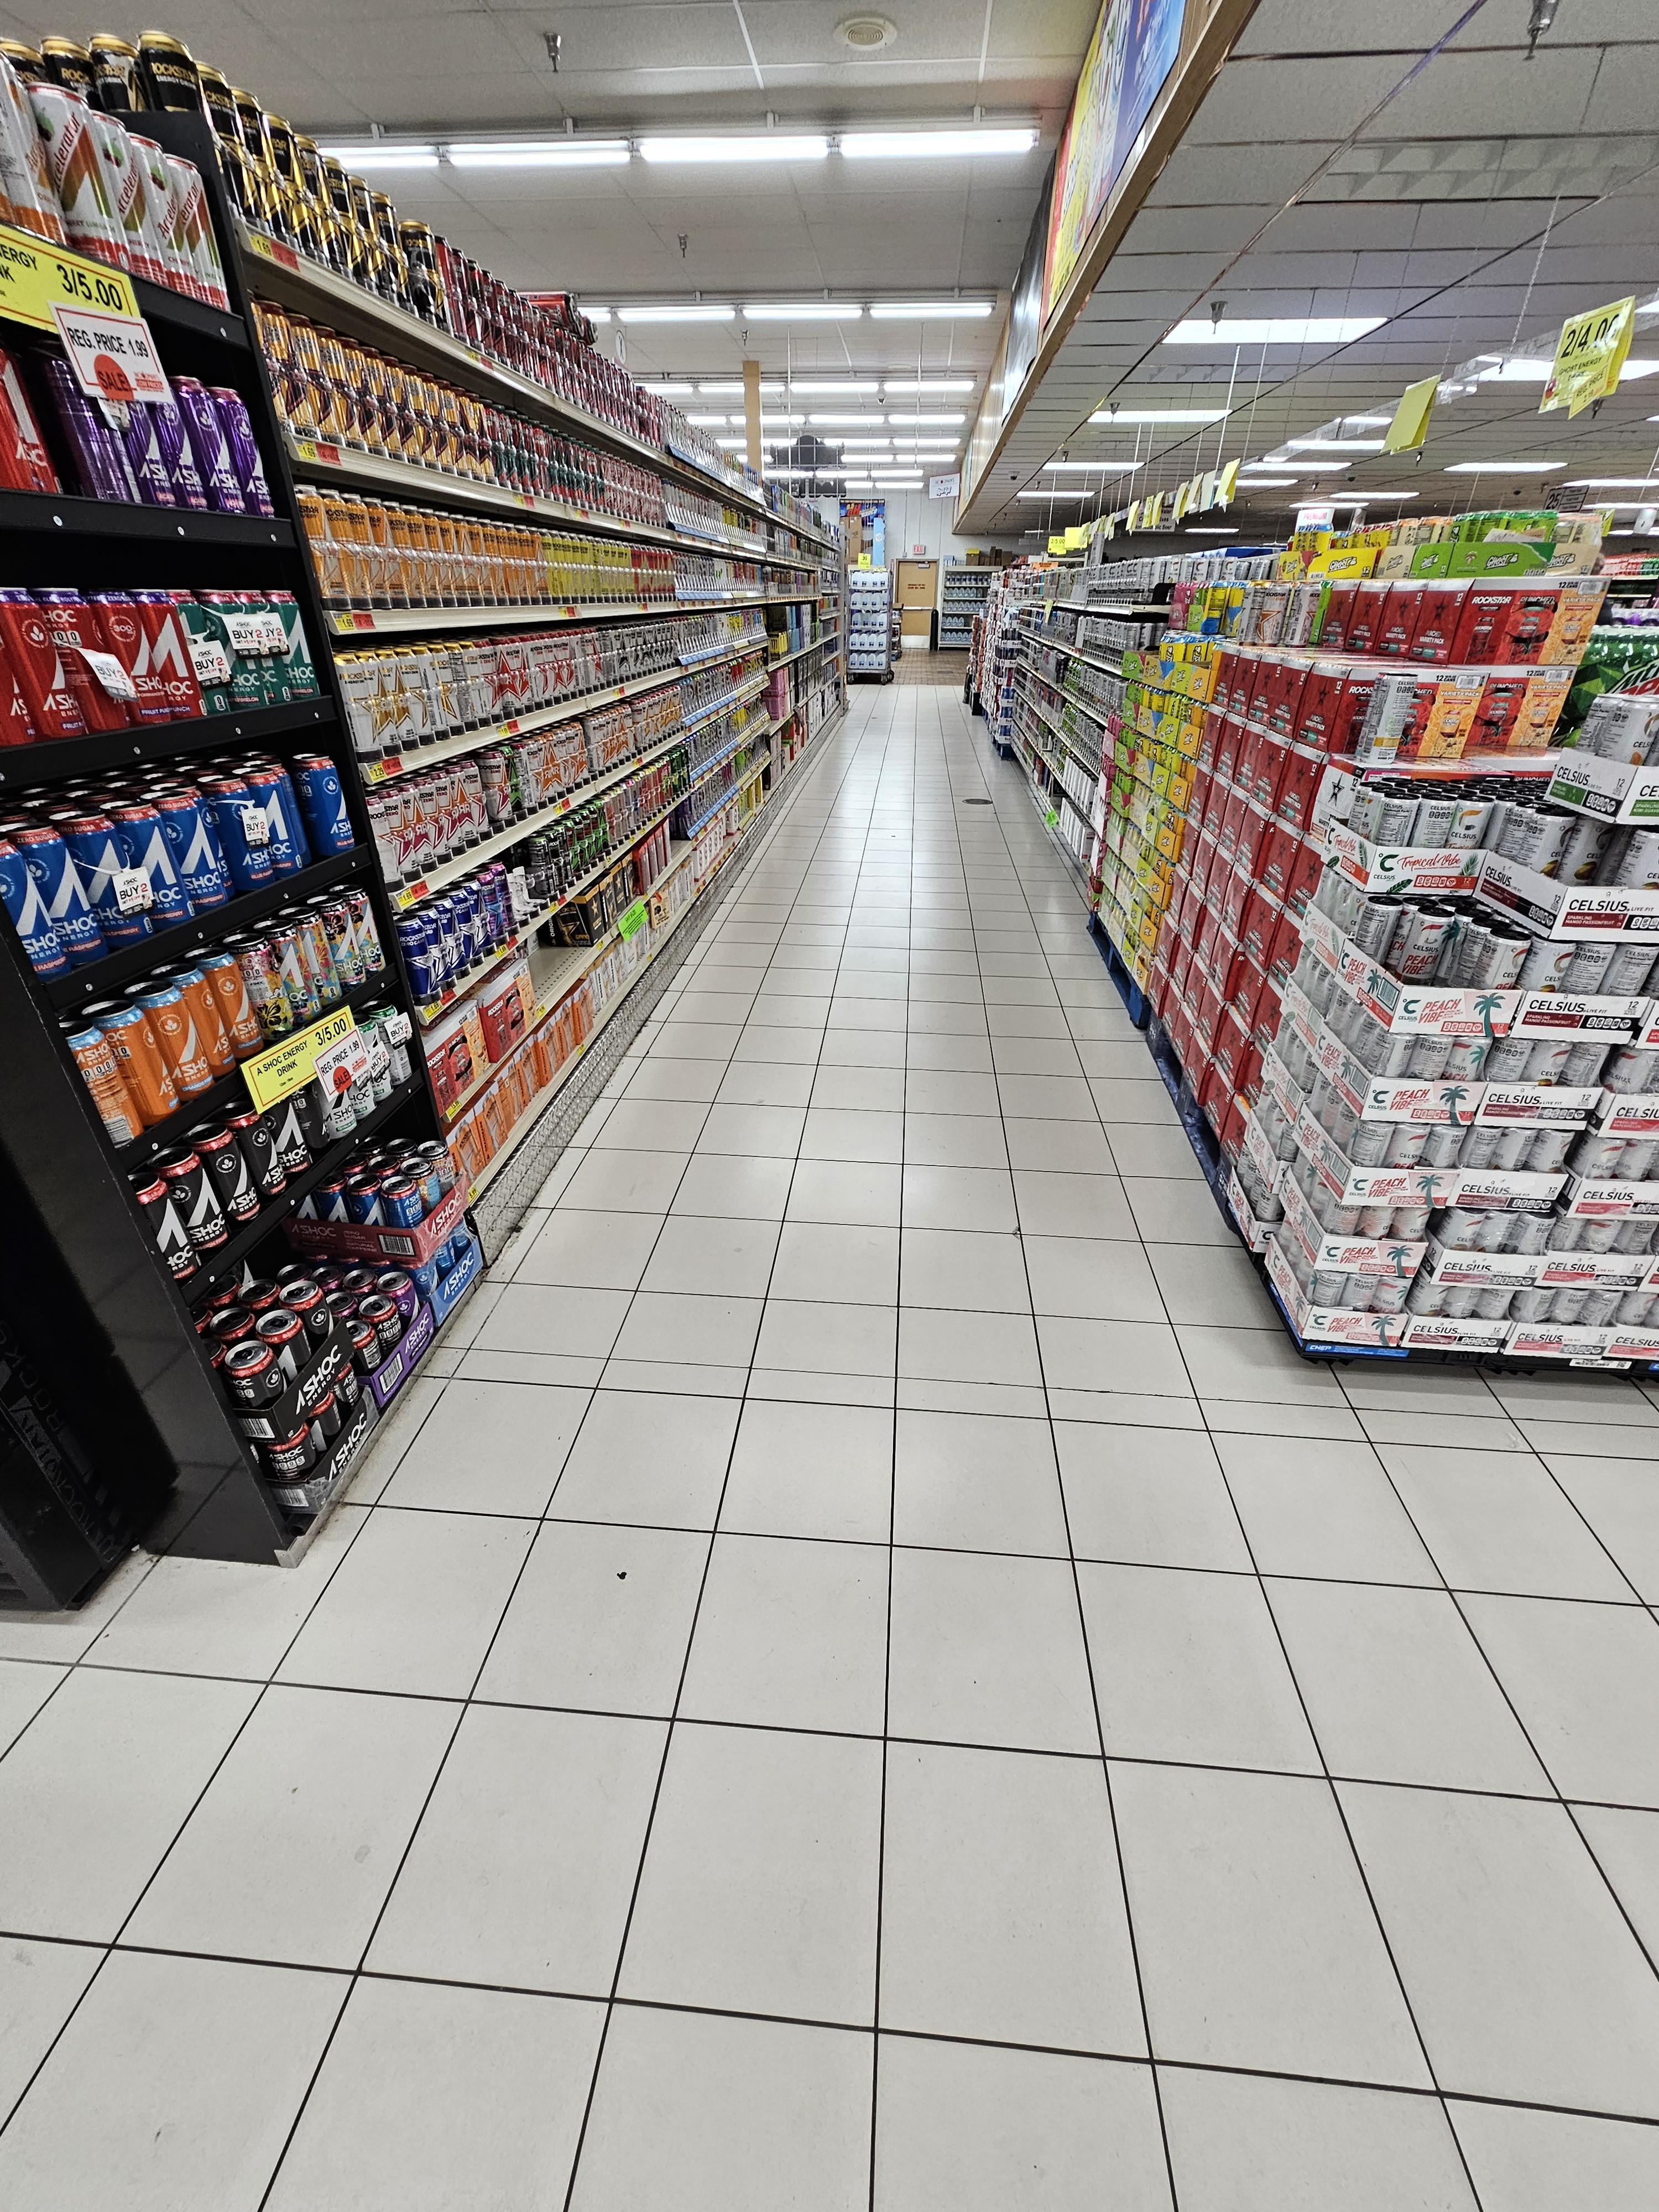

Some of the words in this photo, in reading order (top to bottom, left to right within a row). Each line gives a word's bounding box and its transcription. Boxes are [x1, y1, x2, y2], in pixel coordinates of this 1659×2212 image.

[56, 264, 122, 311] 3/5.00
[67, 327, 96, 350] REG.
[95, 332, 127, 354] PRICE
[128, 337, 149, 358] 1.99
[1578, 356, 1603, 370] ENERGY
[1547, 491, 1561, 509] 25
[1329, 556, 1351, 573] GHOST
[1485, 554, 1511, 570] GHOST
[1472, 596, 1514, 604] ROCKSTAR
[342, 618, 353, 628] 1.69
[232, 629, 254, 639] BUY
[255, 629, 263, 639] 2
[195, 657, 215, 671] BUY
[215, 656, 225, 666] 2
[95, 665, 118, 679] BUY
[1337, 681, 1342, 690] 12
[373, 766, 384, 776] 2.29
[1557, 765, 1591, 786] CELSIUS
[1617, 778, 1625, 788] 12
[246, 822, 260, 832] BUY
[1451, 831, 1477, 839] CELSIUS
[1397, 855, 1438, 872] Tropical
[1438, 853, 1462, 867] Vibe
[1485, 865, 1511, 887] CELSIUS
[119, 885, 139, 900] BUY
[140, 883, 148, 893] 2
[403, 891, 413, 901] 1.69
[1554, 894, 1561, 904] 12
[1568, 899, 1629, 912] CELSIUS
[1577, 946, 1600, 955] CELSIUS
[1405, 954, 1438, 964] PEACH
[1348, 958, 1367, 975] PEACH
[1401, 964, 1425, 975] VIBE
[430, 1003, 440, 1013] 1.69
[488, 1000, 504, 1016] ROCKSTAR
[1422, 999, 1462, 1013] PEACH
[1528, 999, 1586, 1013] CELSIUS
[1418, 1012, 1444, 1024] VIBE
[315, 1018, 347, 1047] 3/5.00
[390, 1027, 405, 1038] BUY
[404, 1022, 409, 1030] 2
[1497, 1040, 1518, 1050] CELSIUS
[256, 1067, 263, 1076] A
[263, 1055, 283, 1073] SHOC
[283, 1040, 309, 1062] ENERGY
[320, 1060, 333, 1077] REG.
[332, 1050, 349, 1067] PRICE
[349, 1040, 361, 1054] 1.99
[1325, 1042, 1342, 1062] PEACH
[276, 1059, 298, 1077] DRINK
[1392, 1088, 1431, 1101] PEACH
[1488, 1093, 1540, 1105] CELSIUS
[1303, 1123, 1321, 1143] PEACH
[1371, 1177, 1407, 1190] PEACH
[1461, 1183, 1510, 1196] CELSIUS
[1367, 1189, 1391, 1198] VIBE
[1583, 1191, 1635, 1201] CELSIUS
[1343, 1246, 1377, 1256] PEACH
[1443, 1261, 1491, 1272] CELSIUS
[1547, 1261, 1597, 1272] CELSIUS
[1330, 1317, 1363, 1326] PEACH
[1413, 1324, 1458, 1334] CELSIUS
[1517, 1333, 1563, 1343] CELSIUS
[307, 1368, 336, 1407] ENERGY
